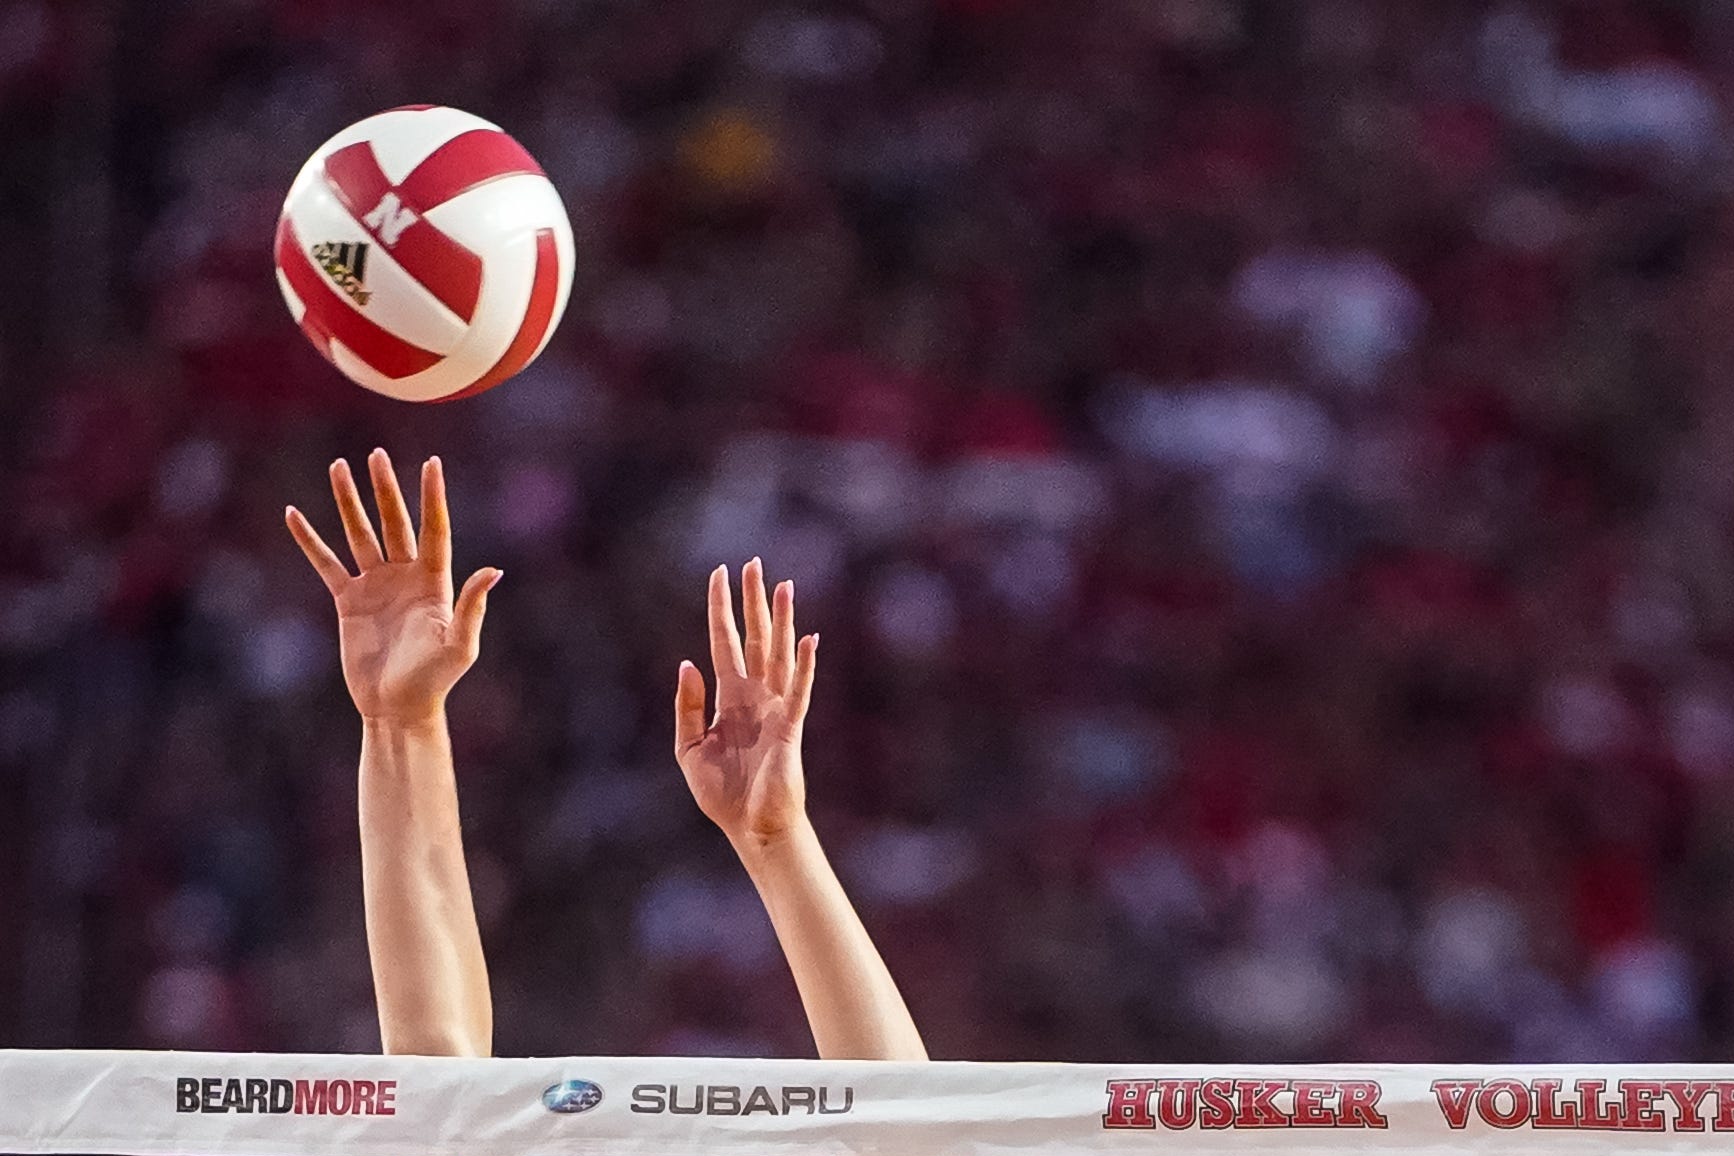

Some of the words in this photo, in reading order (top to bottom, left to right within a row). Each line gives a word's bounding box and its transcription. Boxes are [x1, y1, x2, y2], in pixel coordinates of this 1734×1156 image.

[362, 191, 419, 245] N
[176, 1077, 397, 1116] BEARDMORE
[630, 1083, 854, 1116] SUBARU
[1102, 1078, 1389, 1130] HUSKER
